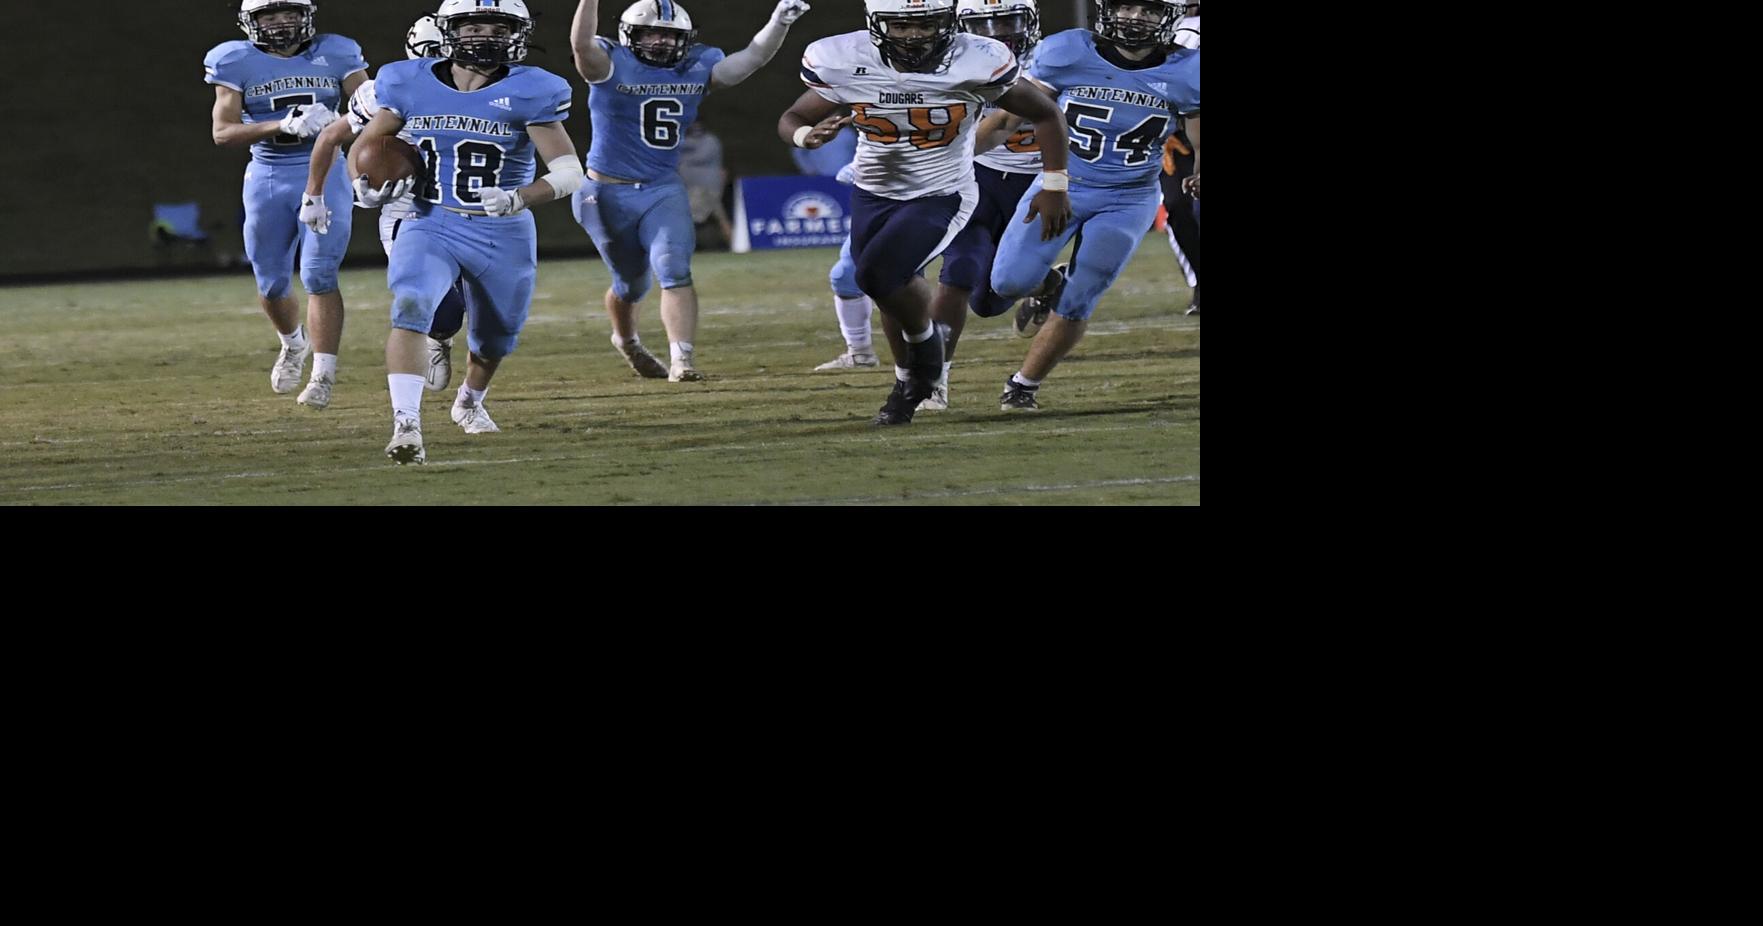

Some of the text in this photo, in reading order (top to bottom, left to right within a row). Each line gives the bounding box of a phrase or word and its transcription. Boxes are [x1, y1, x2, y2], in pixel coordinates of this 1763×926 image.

[640, 97, 684, 150] 6
[879, 92, 924, 105] COUGARS
[851, 102, 968, 150] 58
[1064, 99, 1171, 167] 54
[416, 136, 507, 206] 18
